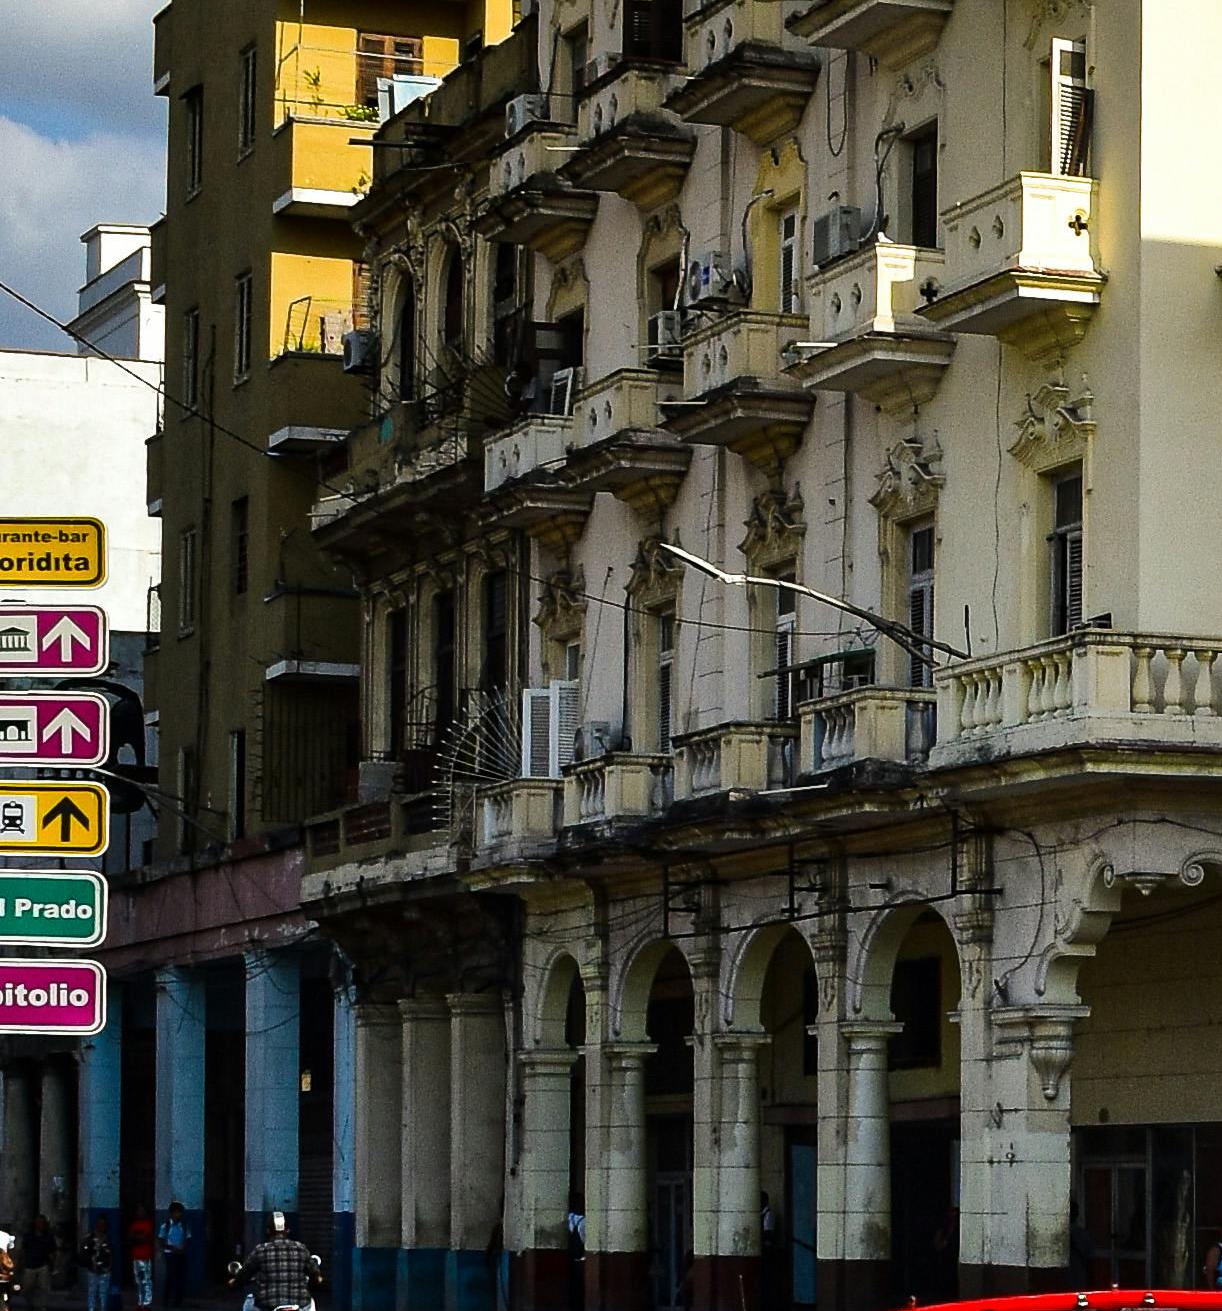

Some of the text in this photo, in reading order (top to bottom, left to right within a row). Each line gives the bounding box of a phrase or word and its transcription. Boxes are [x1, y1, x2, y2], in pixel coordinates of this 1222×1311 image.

[0, 529, 89, 543] rante-bar
[14, 898, 93, 919] Prado
[0, 982, 89, 1007] itolio
